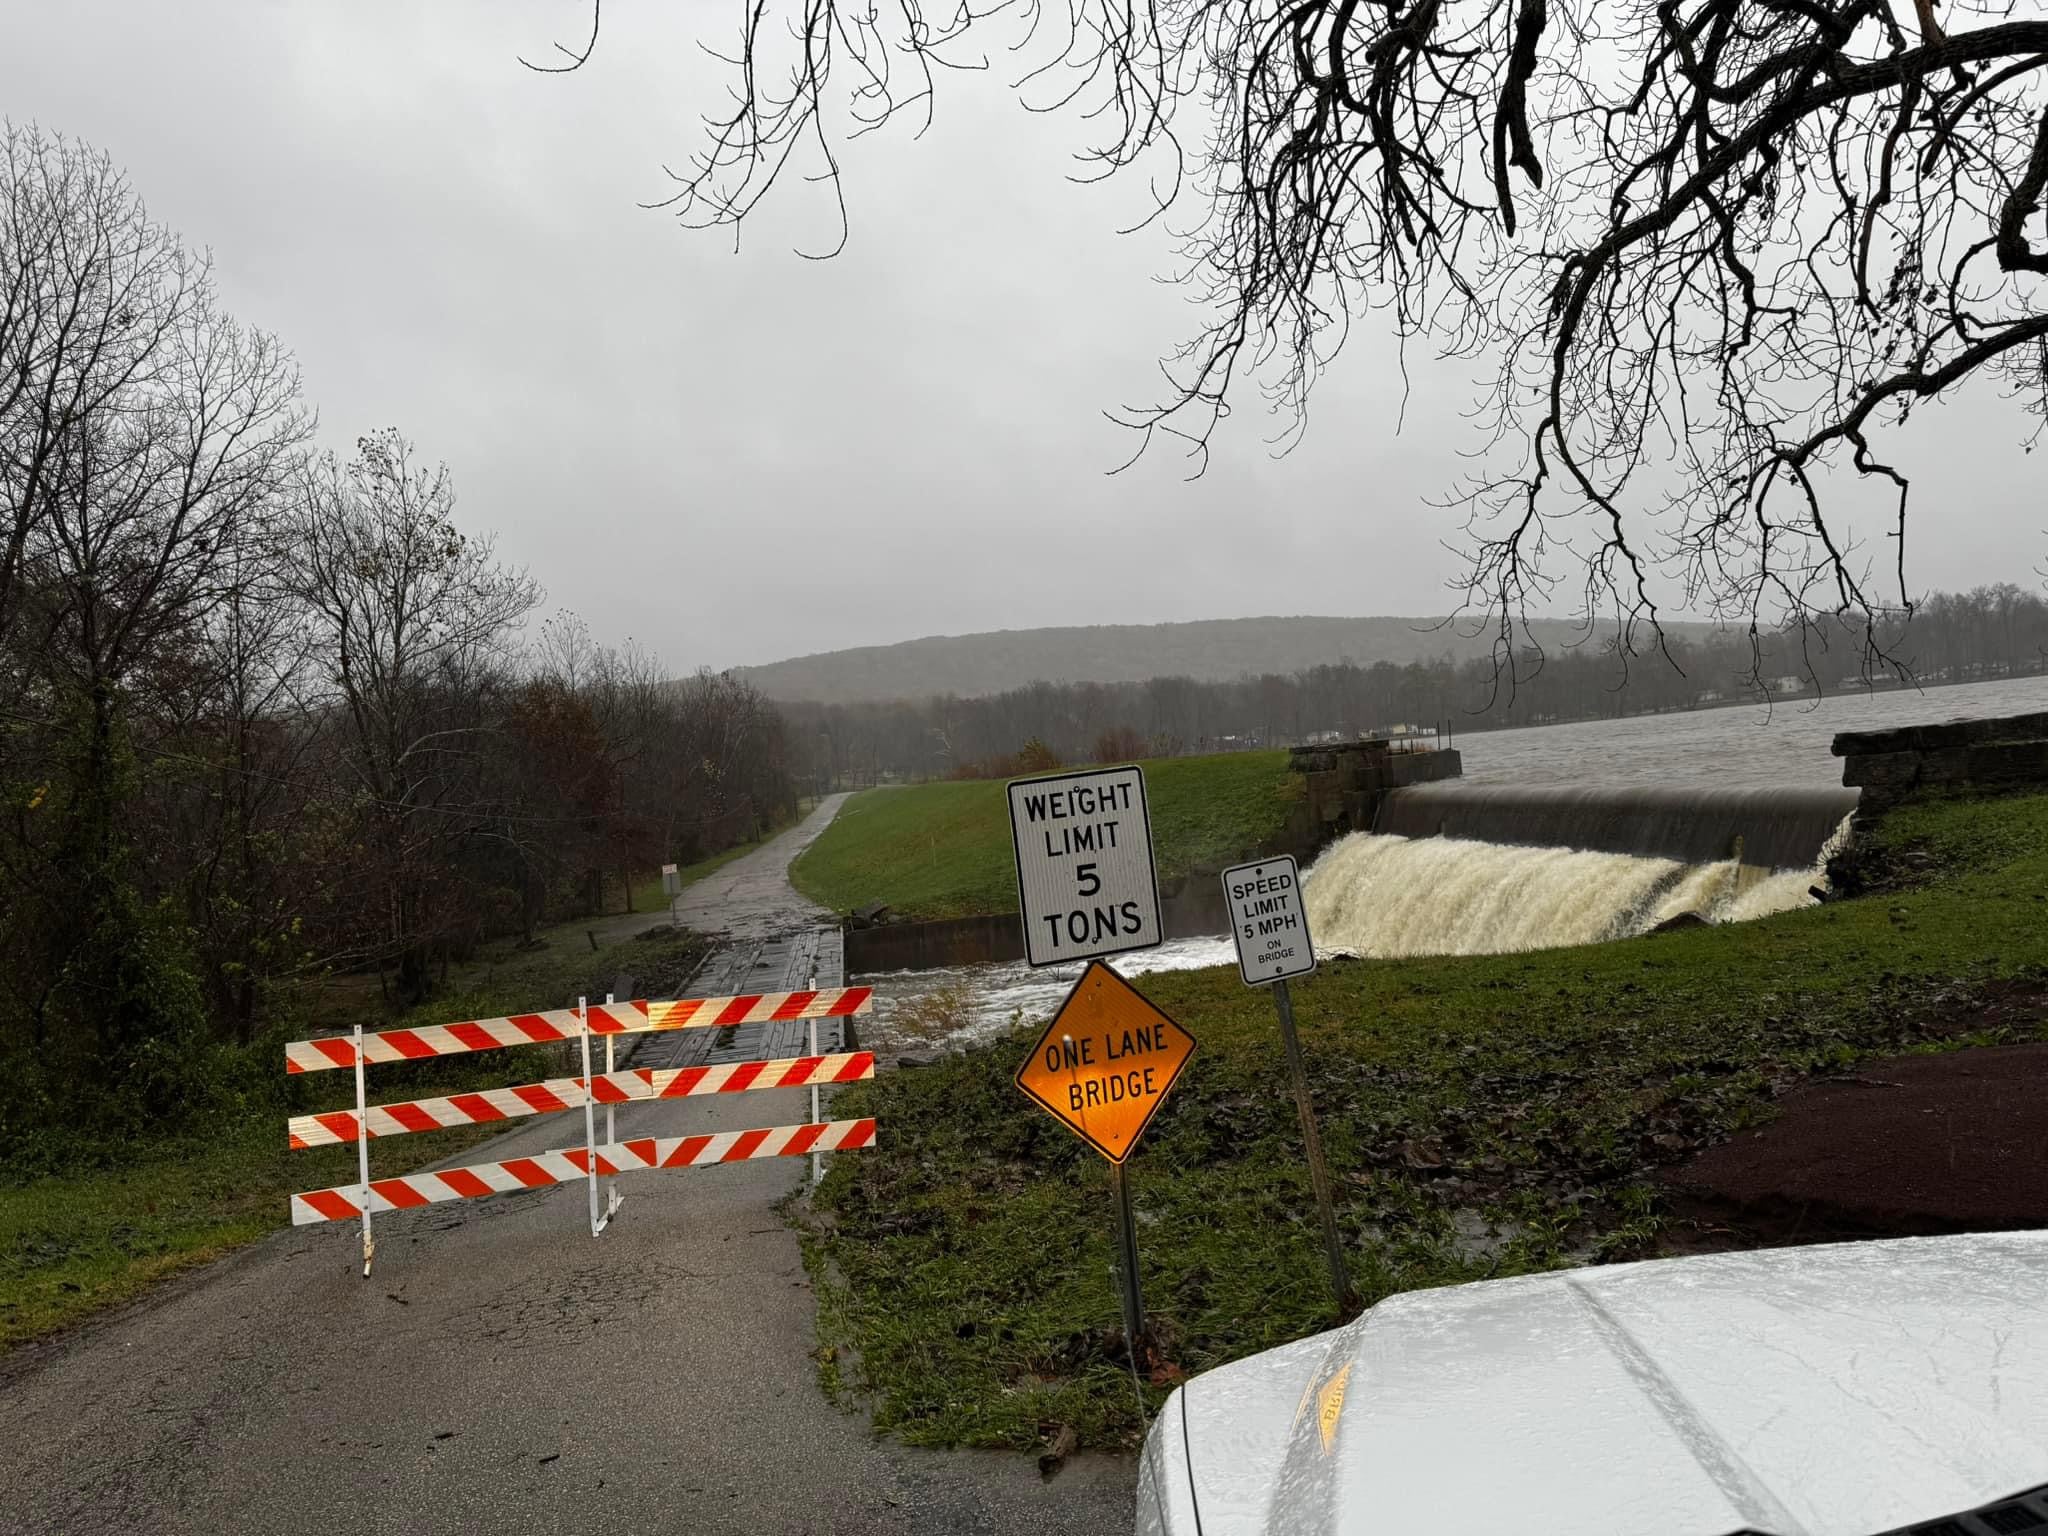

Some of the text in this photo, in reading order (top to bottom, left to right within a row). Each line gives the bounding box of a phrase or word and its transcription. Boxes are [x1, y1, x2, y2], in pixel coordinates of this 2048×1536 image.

[1024, 782, 1132, 823] WEIGHT
[1045, 821, 1119, 857] LIMIT
[1076, 863, 1101, 896] 5
[1233, 874, 1292, 900] SPEED
[1243, 895, 1289, 919] LIMIT
[1043, 902, 1142, 947] TONS
[1243, 913, 1297, 939] 5 MPH
[1257, 947, 1295, 964] BRIDGE
[1266, 939, 1282, 950] ON
[1046, 1023, 1168, 1073] ONE LANE
[1069, 1068, 1158, 1112] BRIDGE
